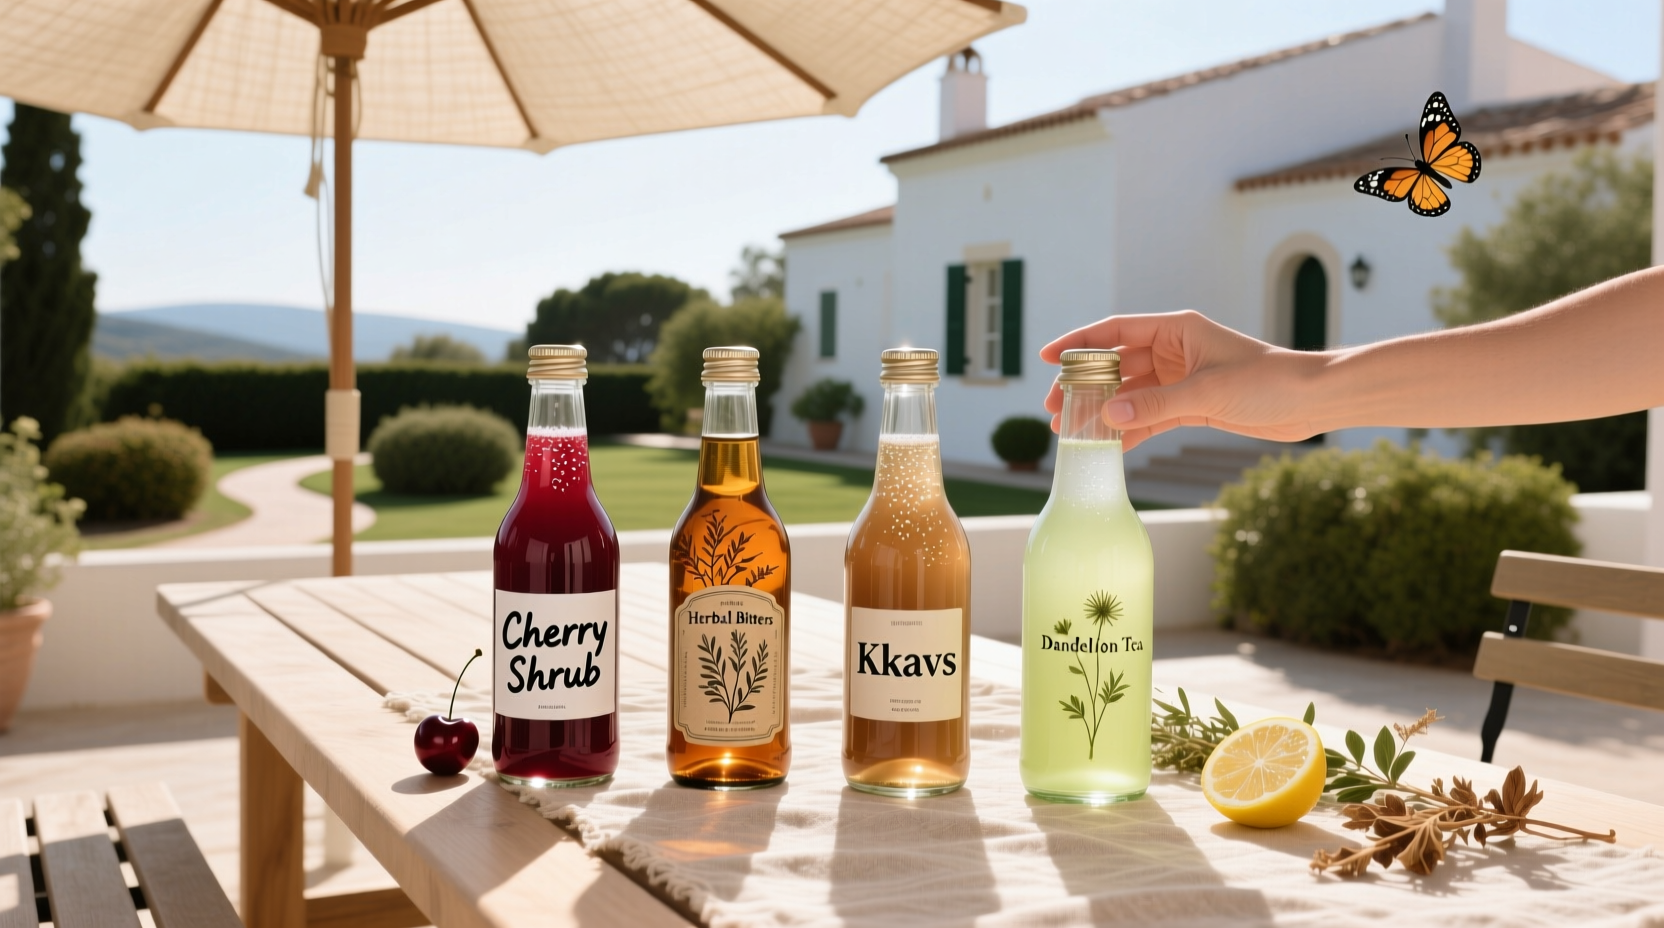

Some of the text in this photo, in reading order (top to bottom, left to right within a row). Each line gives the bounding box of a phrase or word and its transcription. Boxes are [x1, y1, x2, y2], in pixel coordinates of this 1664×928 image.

[502, 610, 608, 657] Cherry
[688, 610, 774, 626] Herbal Bitters
[857, 641, 957, 678] Kkavs
[1121, 636, 1144, 652] Tea
[507, 651, 601, 694] Shrub
